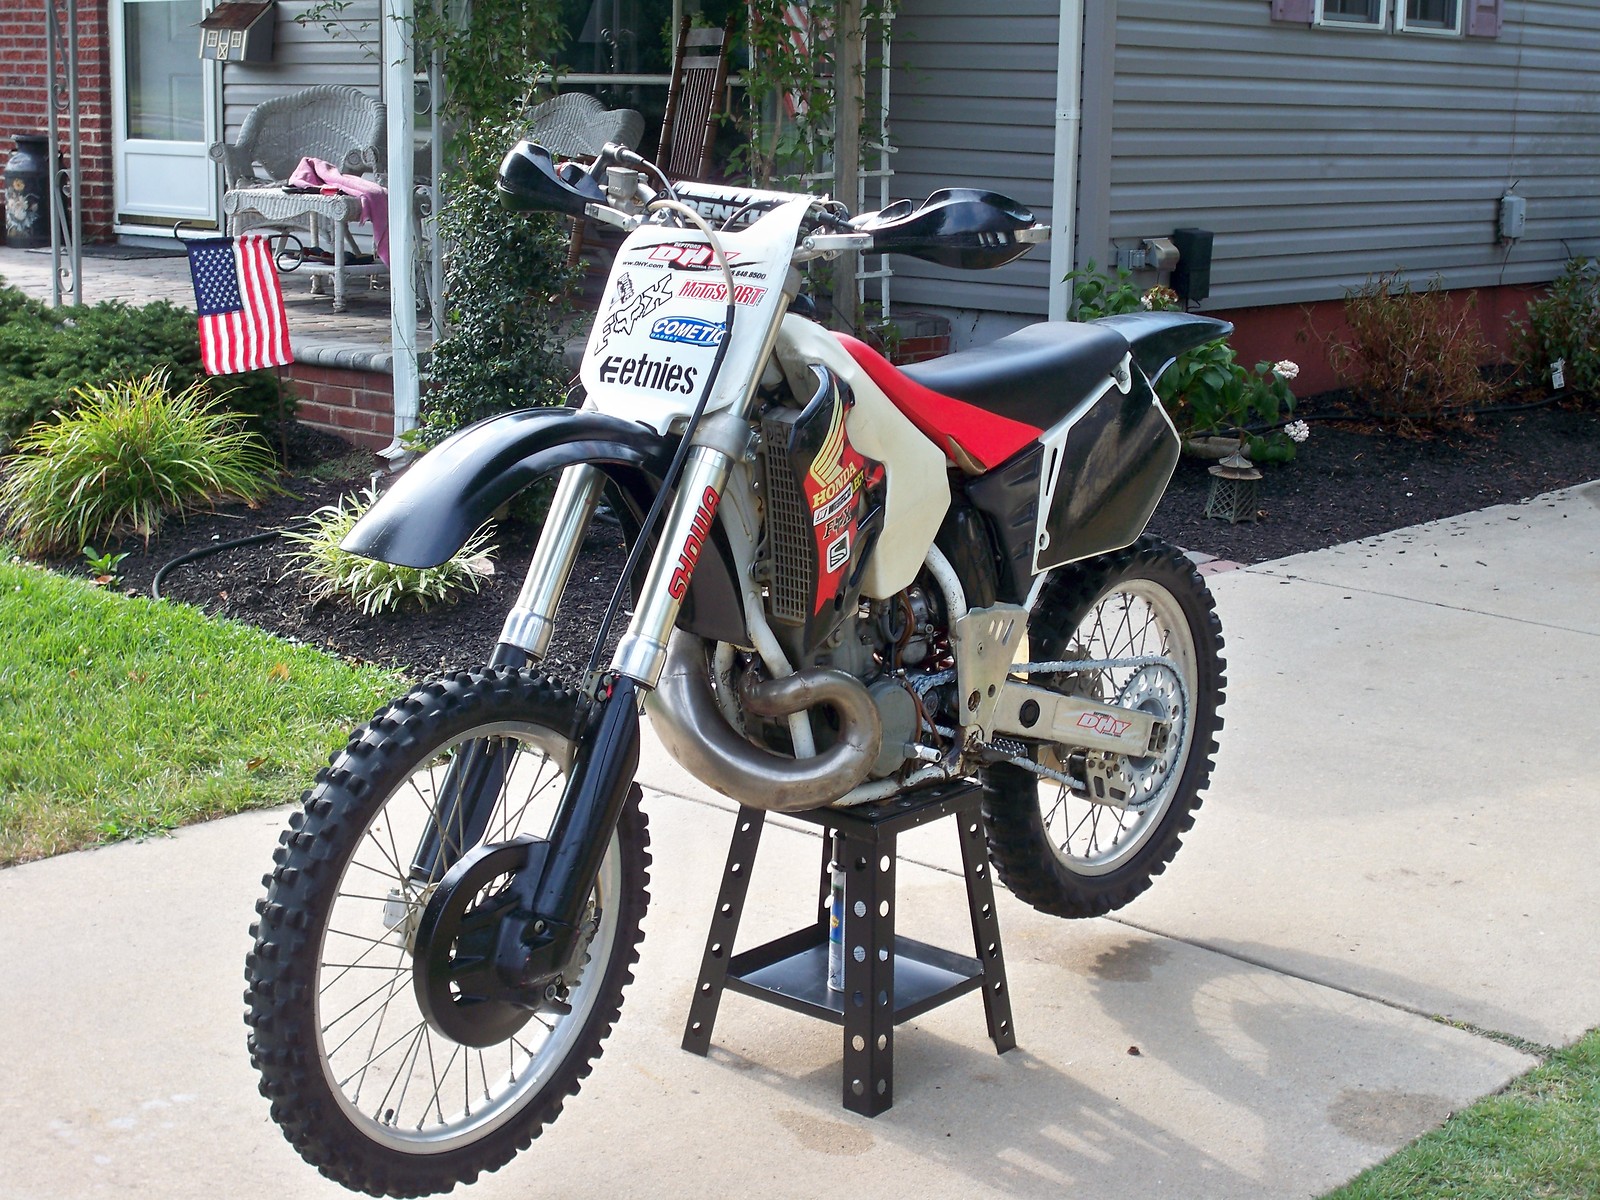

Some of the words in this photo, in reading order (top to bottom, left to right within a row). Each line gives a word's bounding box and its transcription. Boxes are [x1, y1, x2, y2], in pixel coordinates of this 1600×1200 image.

[650, 333, 678, 342] GASKET
[652, 319, 727, 344] COMETIC
[812, 461, 857, 508] HONDA
[667, 485, 721, 605] SHOWA
[1076, 712, 1132, 735] DHY
